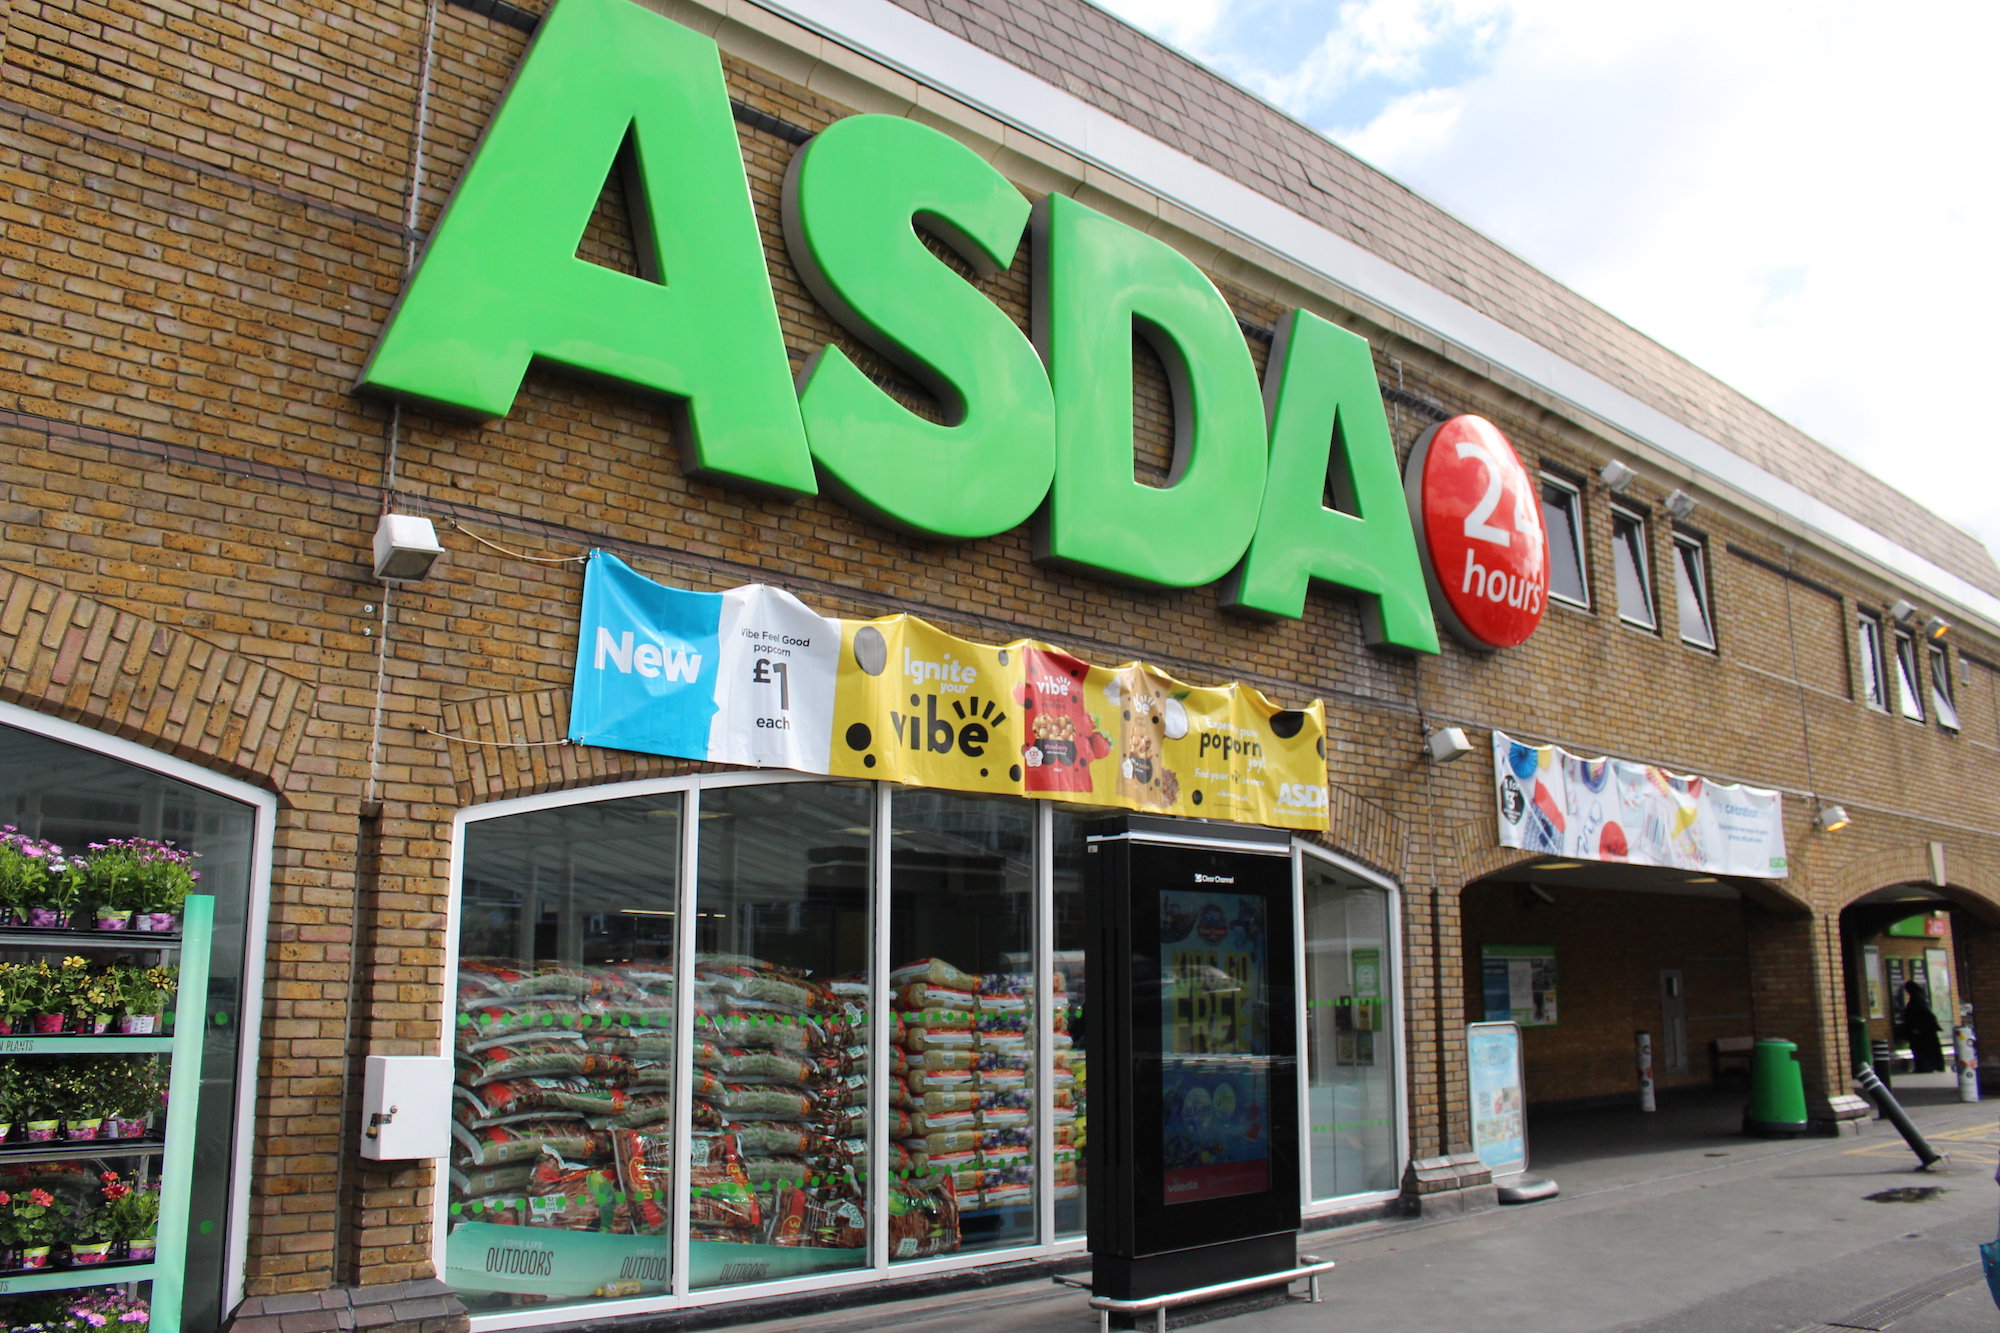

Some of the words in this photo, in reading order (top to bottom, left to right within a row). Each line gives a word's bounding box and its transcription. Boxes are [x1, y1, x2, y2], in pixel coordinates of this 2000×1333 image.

[354, 0, 1440, 654] ASDA
[1455, 442, 1545, 561] 24
[1462, 548, 1543, 615] hours
[741, 627, 760, 640] Vibe
[762, 631, 780, 643] Feel
[782, 635, 811, 648] Good
[754, 644, 791, 657] popcorn
[594, 626, 702, 684] New
[904, 647, 978, 685] Ignite
[753, 658, 789, 711] £1
[940, 682, 969, 694] your
[1036, 675, 1069, 696] vibe
[756, 716, 790, 730] each
[890, 694, 990, 757] vibe
[1276, 783, 1329, 808] ASDA
[1172, 988, 1253, 1054] FREE
[6, 1040, 34, 1051] PLANTS
[503, 1239, 524, 1248] LOVE
[526, 1241, 543, 1249] LIFE
[486, 1247, 554, 1276] OUTDOORS
[719, 1263, 770, 1281] OUTDOORS
